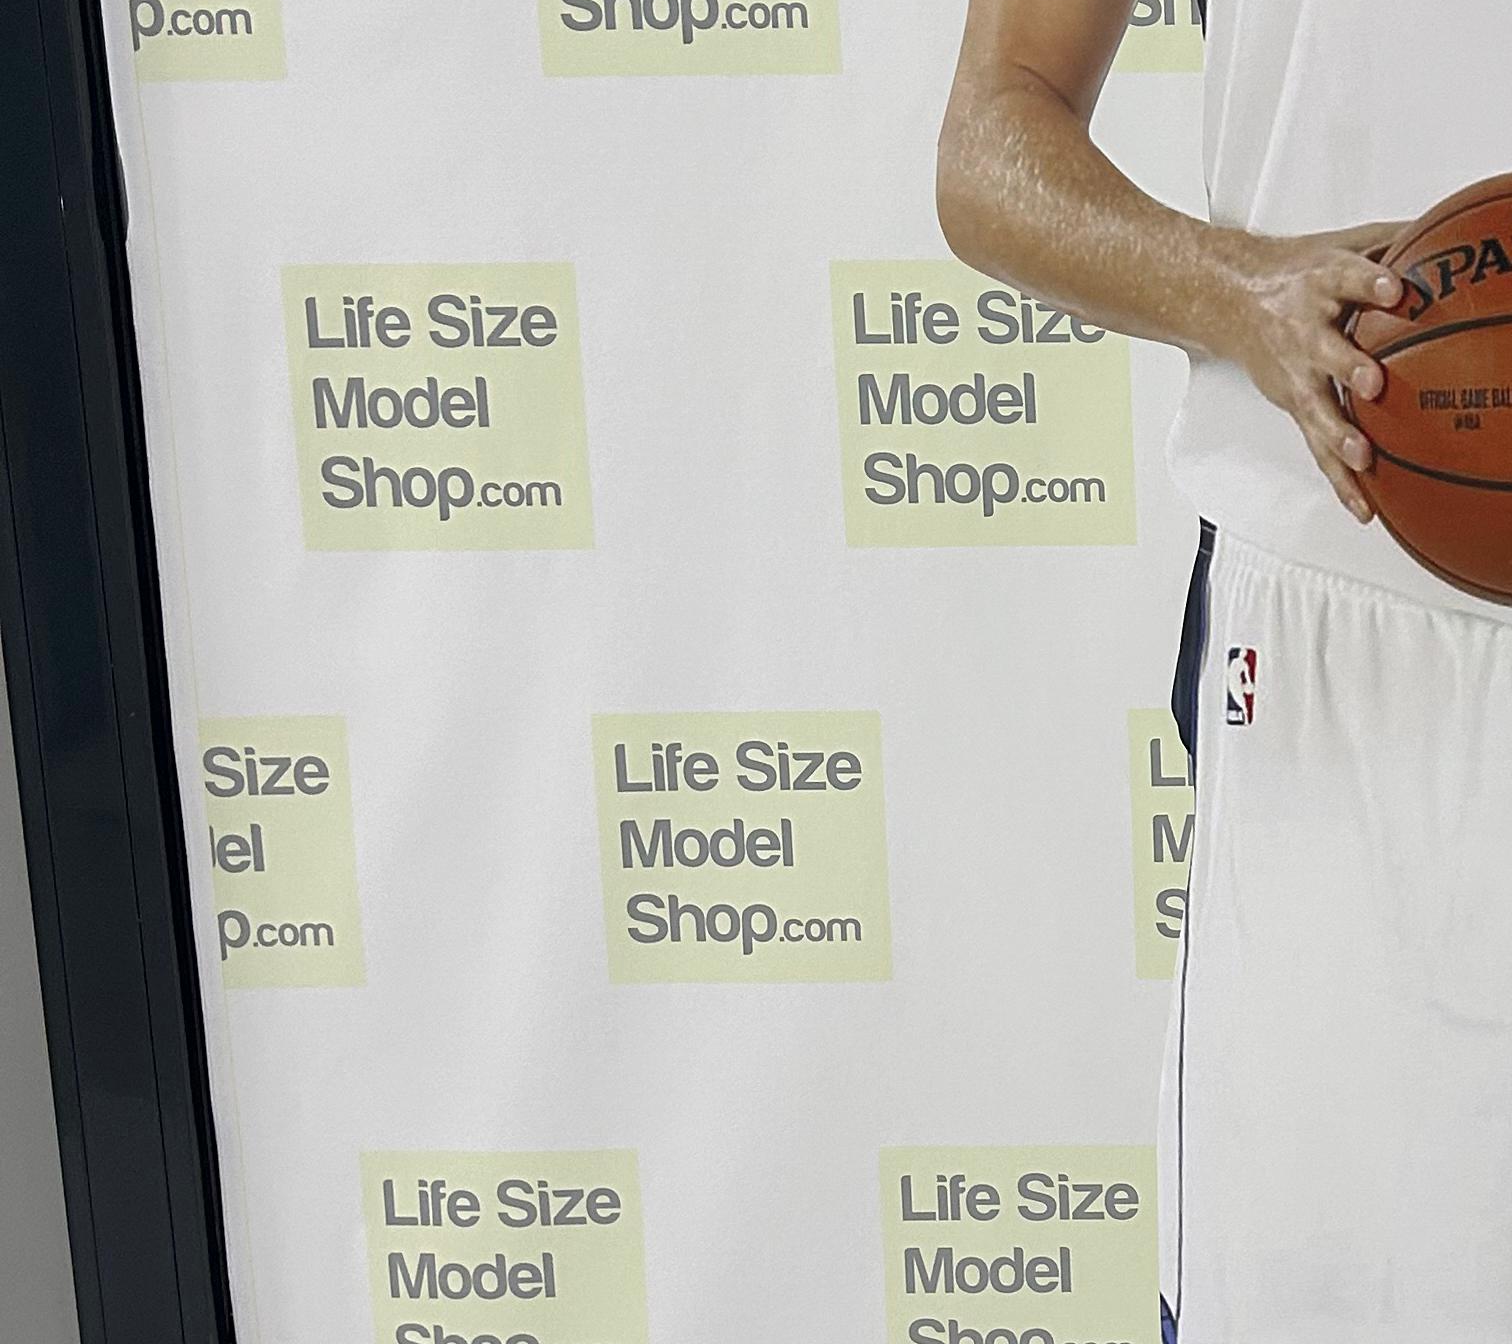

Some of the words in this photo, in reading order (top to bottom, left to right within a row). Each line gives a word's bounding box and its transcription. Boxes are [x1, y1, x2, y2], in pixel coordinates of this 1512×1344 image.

[305, 296, 411, 348] Life
[428, 294, 557, 348] Size
[853, 292, 959, 345] Life
[312, 377, 489, 429] Model
[858, 373, 1036, 425] Model
[321, 456, 562, 521] Shop.com
[864, 452, 1105, 517] Shop.com
[203, 746, 329, 797] Size
[614, 743, 719, 792] Life
[736, 741, 862, 791] Size
[209, 823, 265, 873] el
[620, 818, 793, 868] Model
[627, 894, 861, 955] Shop.com
[383, 1179, 480, 1227] Life
[497, 1180, 621, 1228] Size
[901, 1175, 1000, 1221] Life
[1017, 1173, 1139, 1221] Size
[388, 1252, 556, 1300] Model
[904, 1247, 1071, 1294] Model
